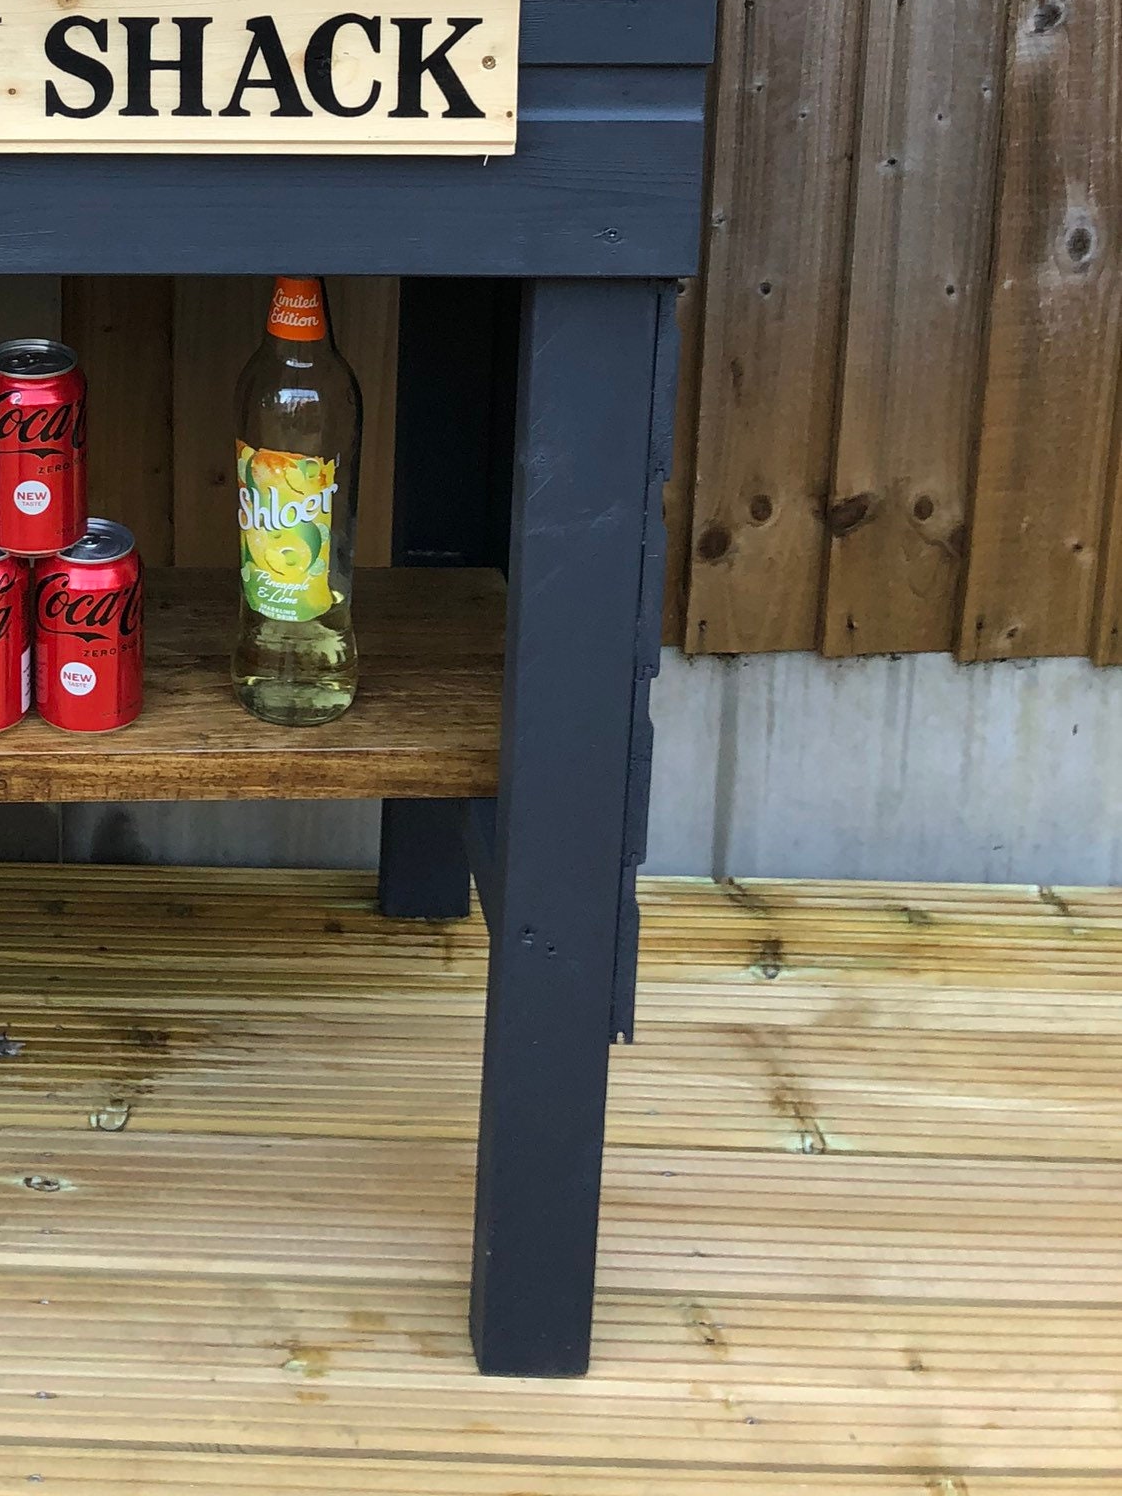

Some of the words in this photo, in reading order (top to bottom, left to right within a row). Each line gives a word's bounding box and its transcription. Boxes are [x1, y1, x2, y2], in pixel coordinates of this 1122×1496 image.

[43, 11, 486, 119] SHACK
[273, 287, 319, 309] Limited
[270, 307, 319, 327] Edition
[38, 462, 71, 475] ZERO
[16, 491, 47, 501] NEW
[238, 483, 339, 531] Shloer
[254, 569, 310, 597] Pineapple
[267, 588, 299, 605] Lime
[83, 647, 117, 658] ZERO
[62, 671, 93, 683] NEW
